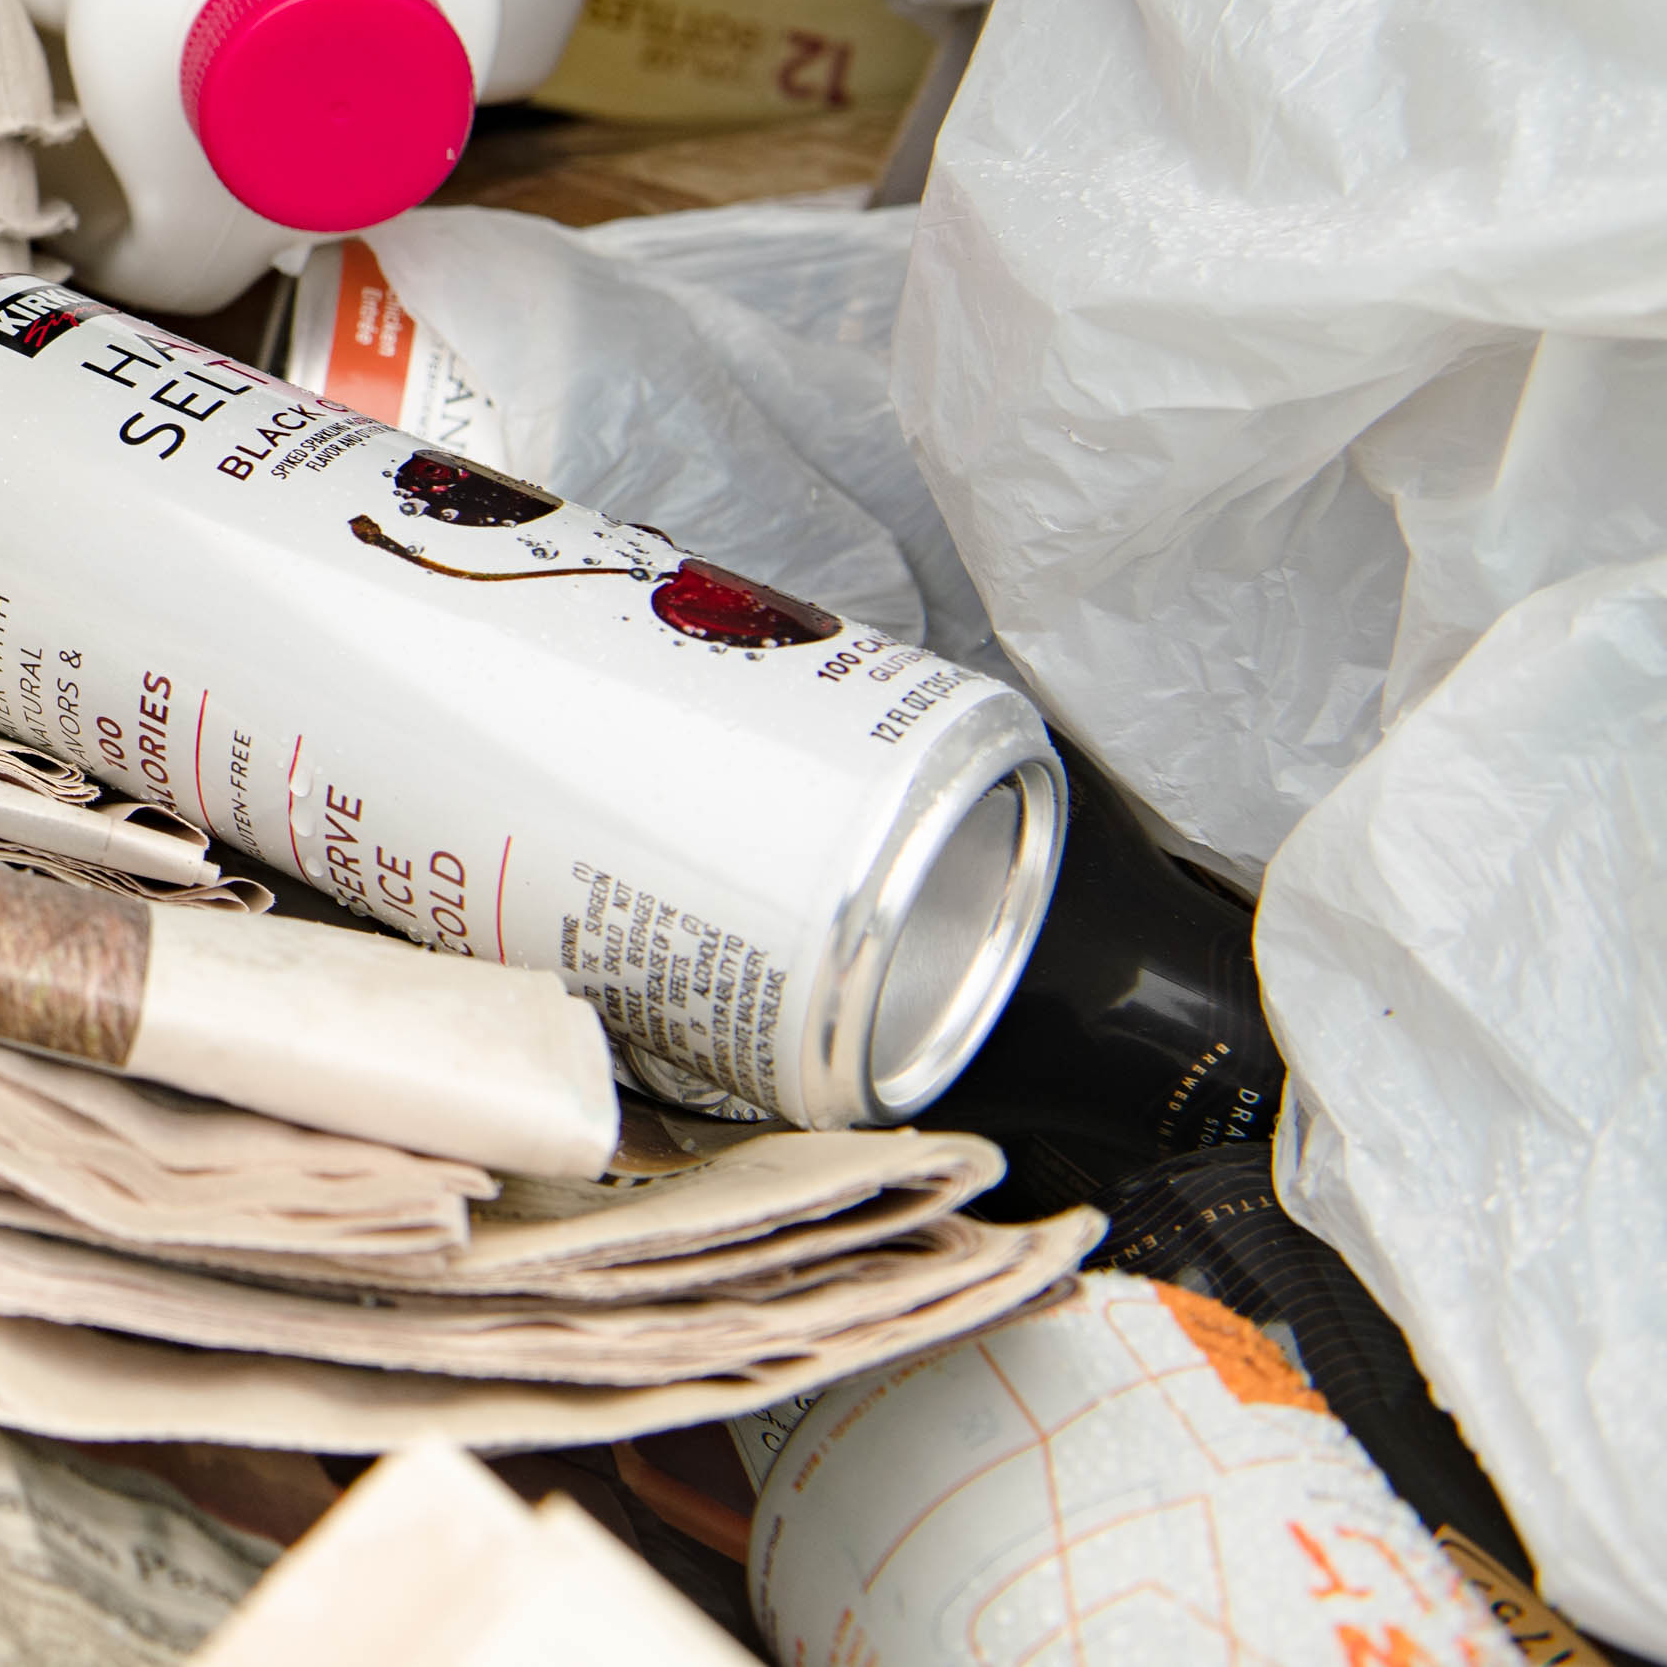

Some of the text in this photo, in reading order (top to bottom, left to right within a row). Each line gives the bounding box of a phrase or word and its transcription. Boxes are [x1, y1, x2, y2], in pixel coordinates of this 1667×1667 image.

[775, 28, 856, 112] 12
[81, 332, 210, 389] HA
[118, 359, 270, 461] SELT
[217, 403, 327, 481] BLACK
[271, 449, 309, 480] SPIKED
[300, 422, 352, 452] SPARKLING
[305, 443, 347, 472] FLAVOR
[337, 433, 364, 448] AND
[59, 649, 83, 669] &
[817, 651, 862, 682] 100
[886, 708, 920, 726] FL
[902, 690, 936, 711] OZ
[96, 716, 129, 772] 100
[870, 722, 904, 744] 12
[324, 785, 375, 913] SERVE
[376, 845, 418, 919] ICE
[429, 851, 475, 958] COLD
[585, 870, 612, 936] SURGEON
[613, 880, 633, 913] NOT
[627, 891, 656, 969] BEVERAGES
[652, 930, 670, 951] OF
[657, 901, 679, 930] THE
[561, 913, 580, 973] WARNING:
[582, 949, 600, 973] THE
[603, 924, 624, 976] SHOULD
[693, 923, 722, 1000] ALCOHOLIC
[724, 933, 745, 953] TO
[647, 951, 669, 1005] BECAUSE
[714, 955, 739, 1005] ABILITY
[690, 1017, 708, 1036] OF
[1168, 1042, 1232, 1112] BREWED
